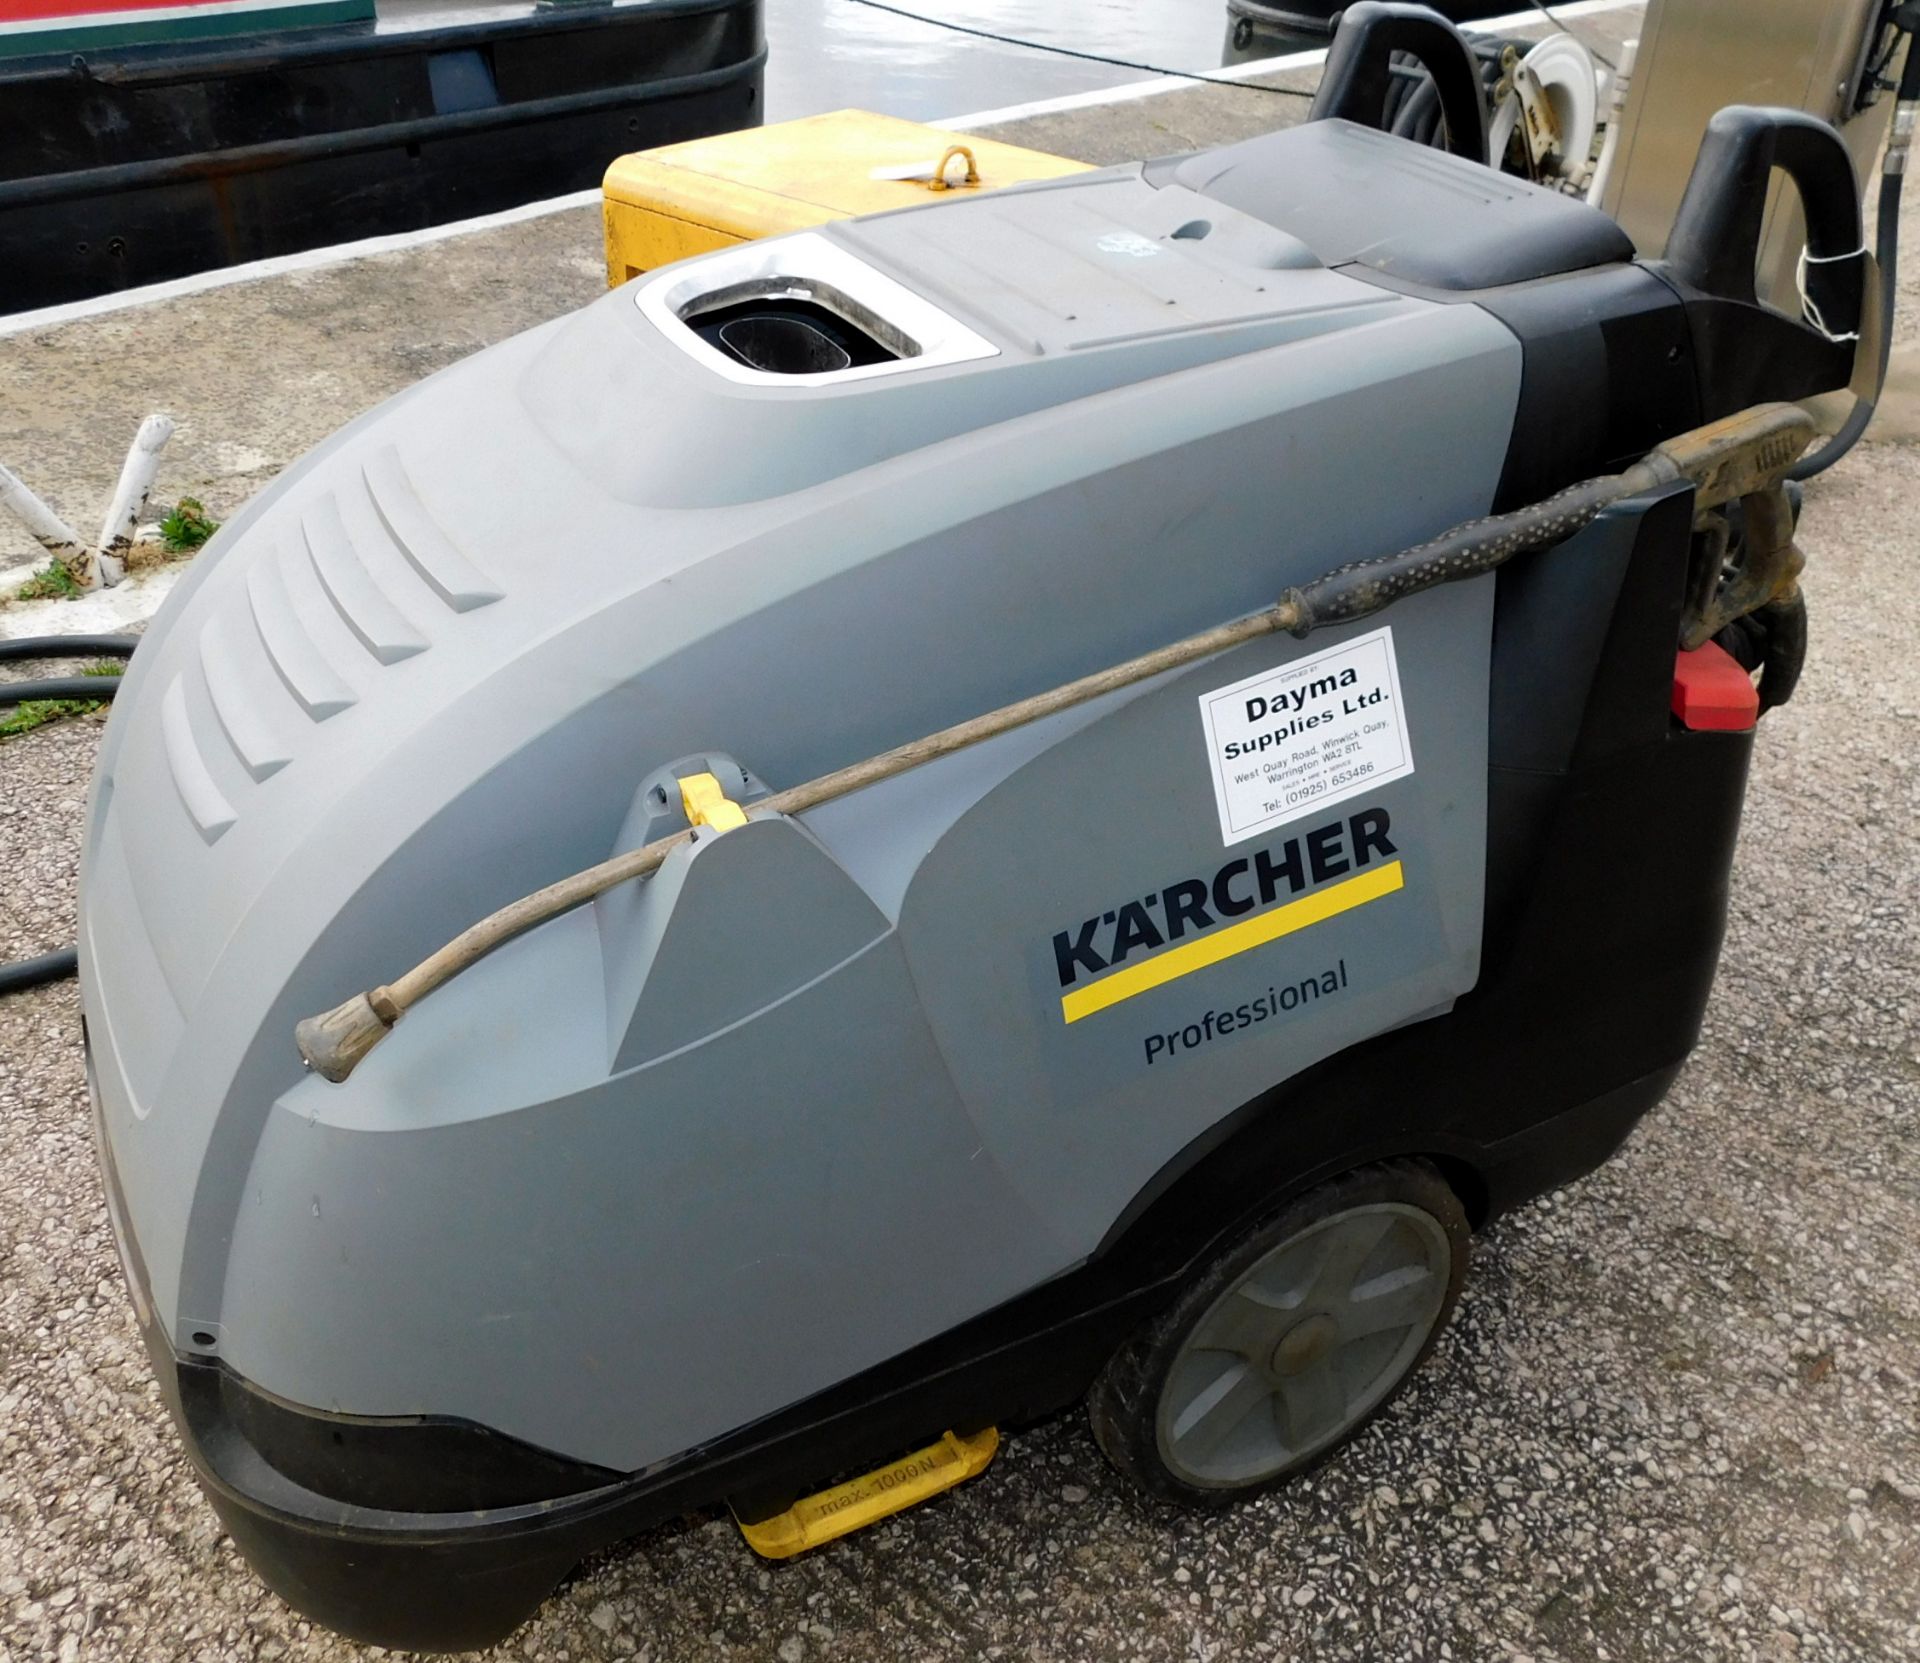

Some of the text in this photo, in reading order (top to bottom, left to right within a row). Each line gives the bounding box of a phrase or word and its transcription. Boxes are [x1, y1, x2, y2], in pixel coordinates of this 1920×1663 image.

[1224, 687, 1389, 760] Supplies Ltd.
[1245, 667, 1358, 723] Dayma
[1234, 768, 1259, 785] West
[1263, 758, 1288, 774] Quay
[1321, 730, 1360, 751] Winwick
[1363, 720, 1390, 735] Quay,
[1266, 760, 1319, 784] Warrington
[1322, 749, 1342, 763] WA2
[1262, 762, 1375, 814] Tel: (01925) 653486
[1052, 807, 1399, 987] KÄRCHER
[1144, 959, 1348, 1065] Professional
[820, 1490, 870, 1515] max.
